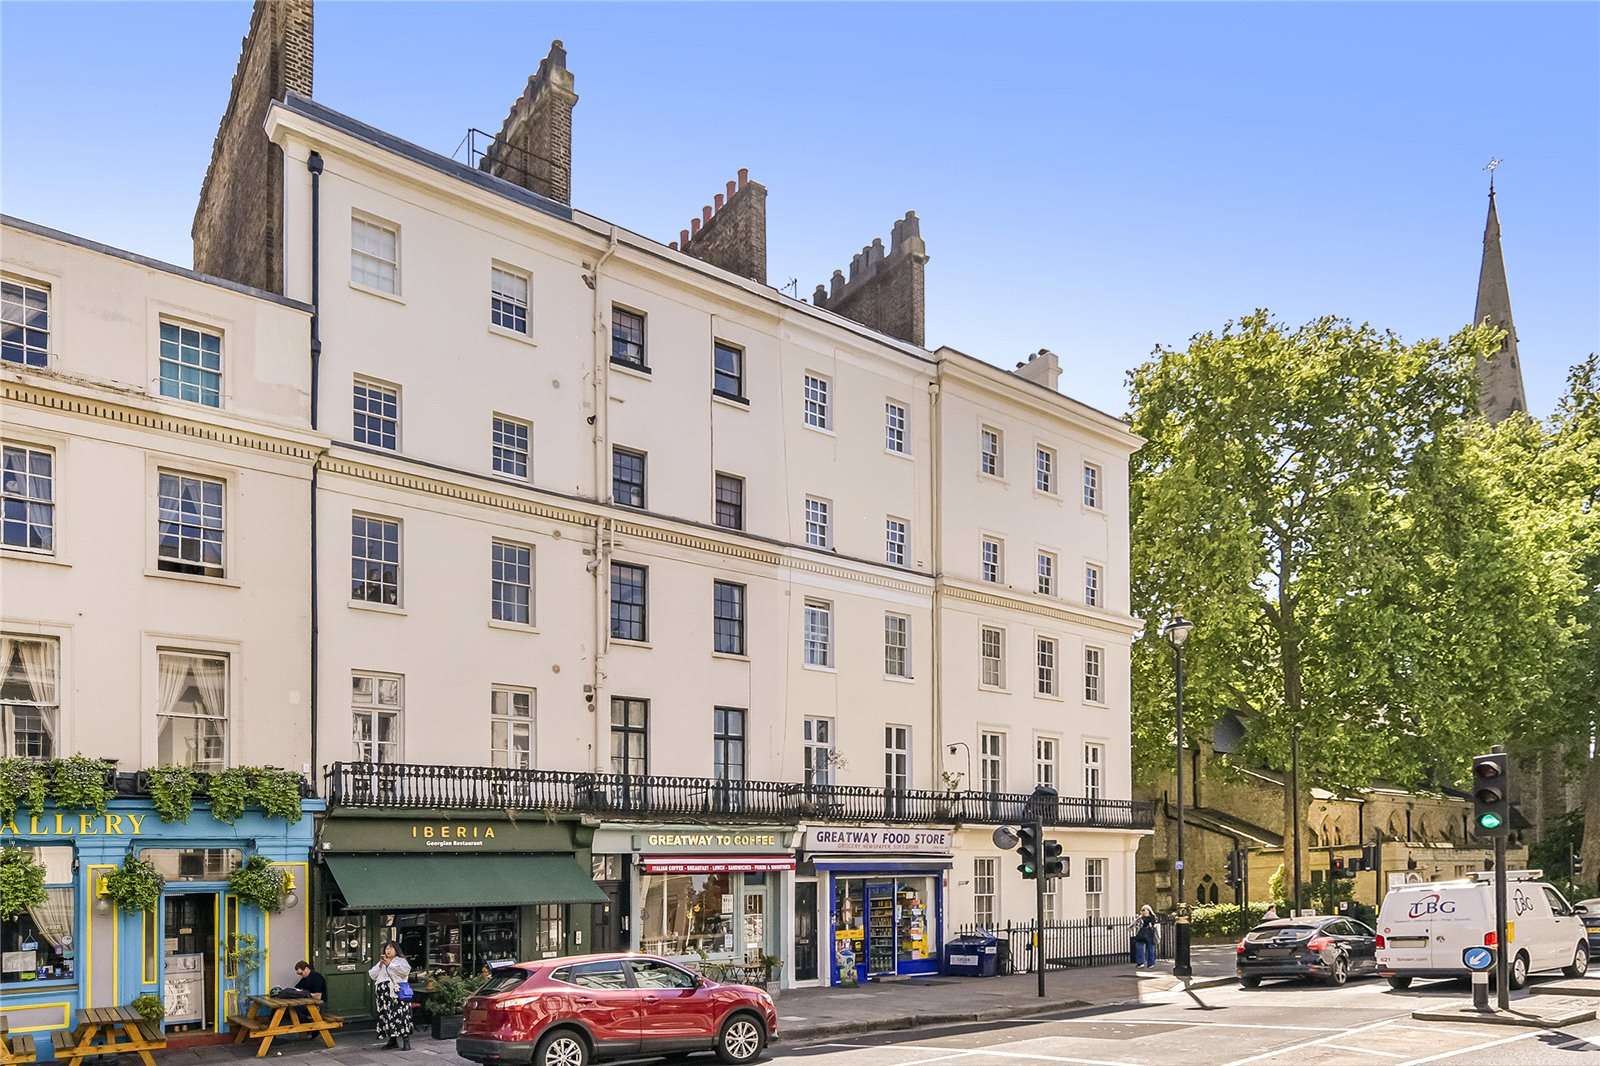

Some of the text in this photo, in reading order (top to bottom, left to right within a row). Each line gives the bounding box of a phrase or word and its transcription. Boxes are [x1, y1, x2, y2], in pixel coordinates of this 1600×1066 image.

[412, 826, 495, 838] IBERIA
[816, 831, 945, 845] GREATWAY FOOD STORE
[649, 835, 775, 846] GREATWAY TO COFFEE
[1410, 901, 1456, 915] TBG
